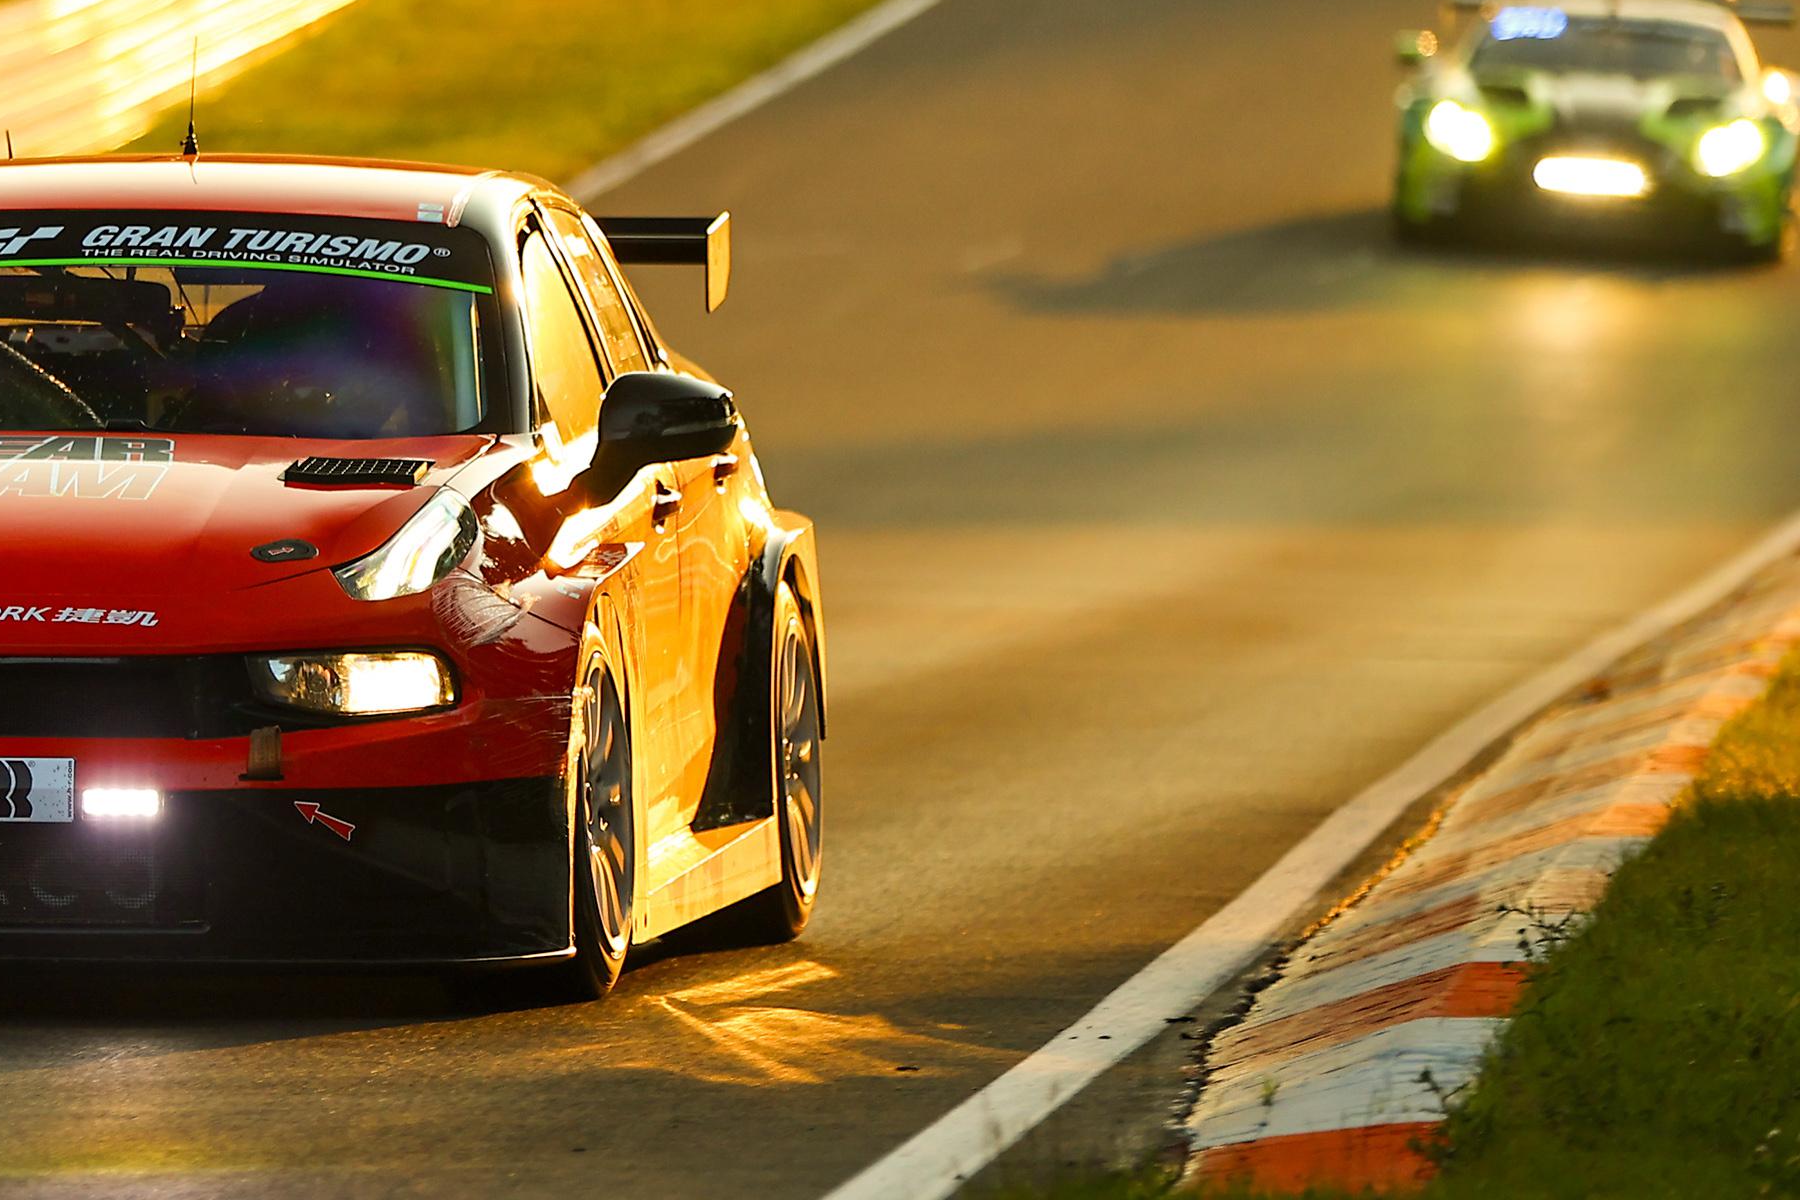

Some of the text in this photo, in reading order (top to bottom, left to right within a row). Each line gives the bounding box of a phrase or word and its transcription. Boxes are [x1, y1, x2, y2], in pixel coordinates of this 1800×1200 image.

[81, 225, 217, 248] GRAN
[81, 248, 416, 275] THE REAL DRIVING SIMULATOR
